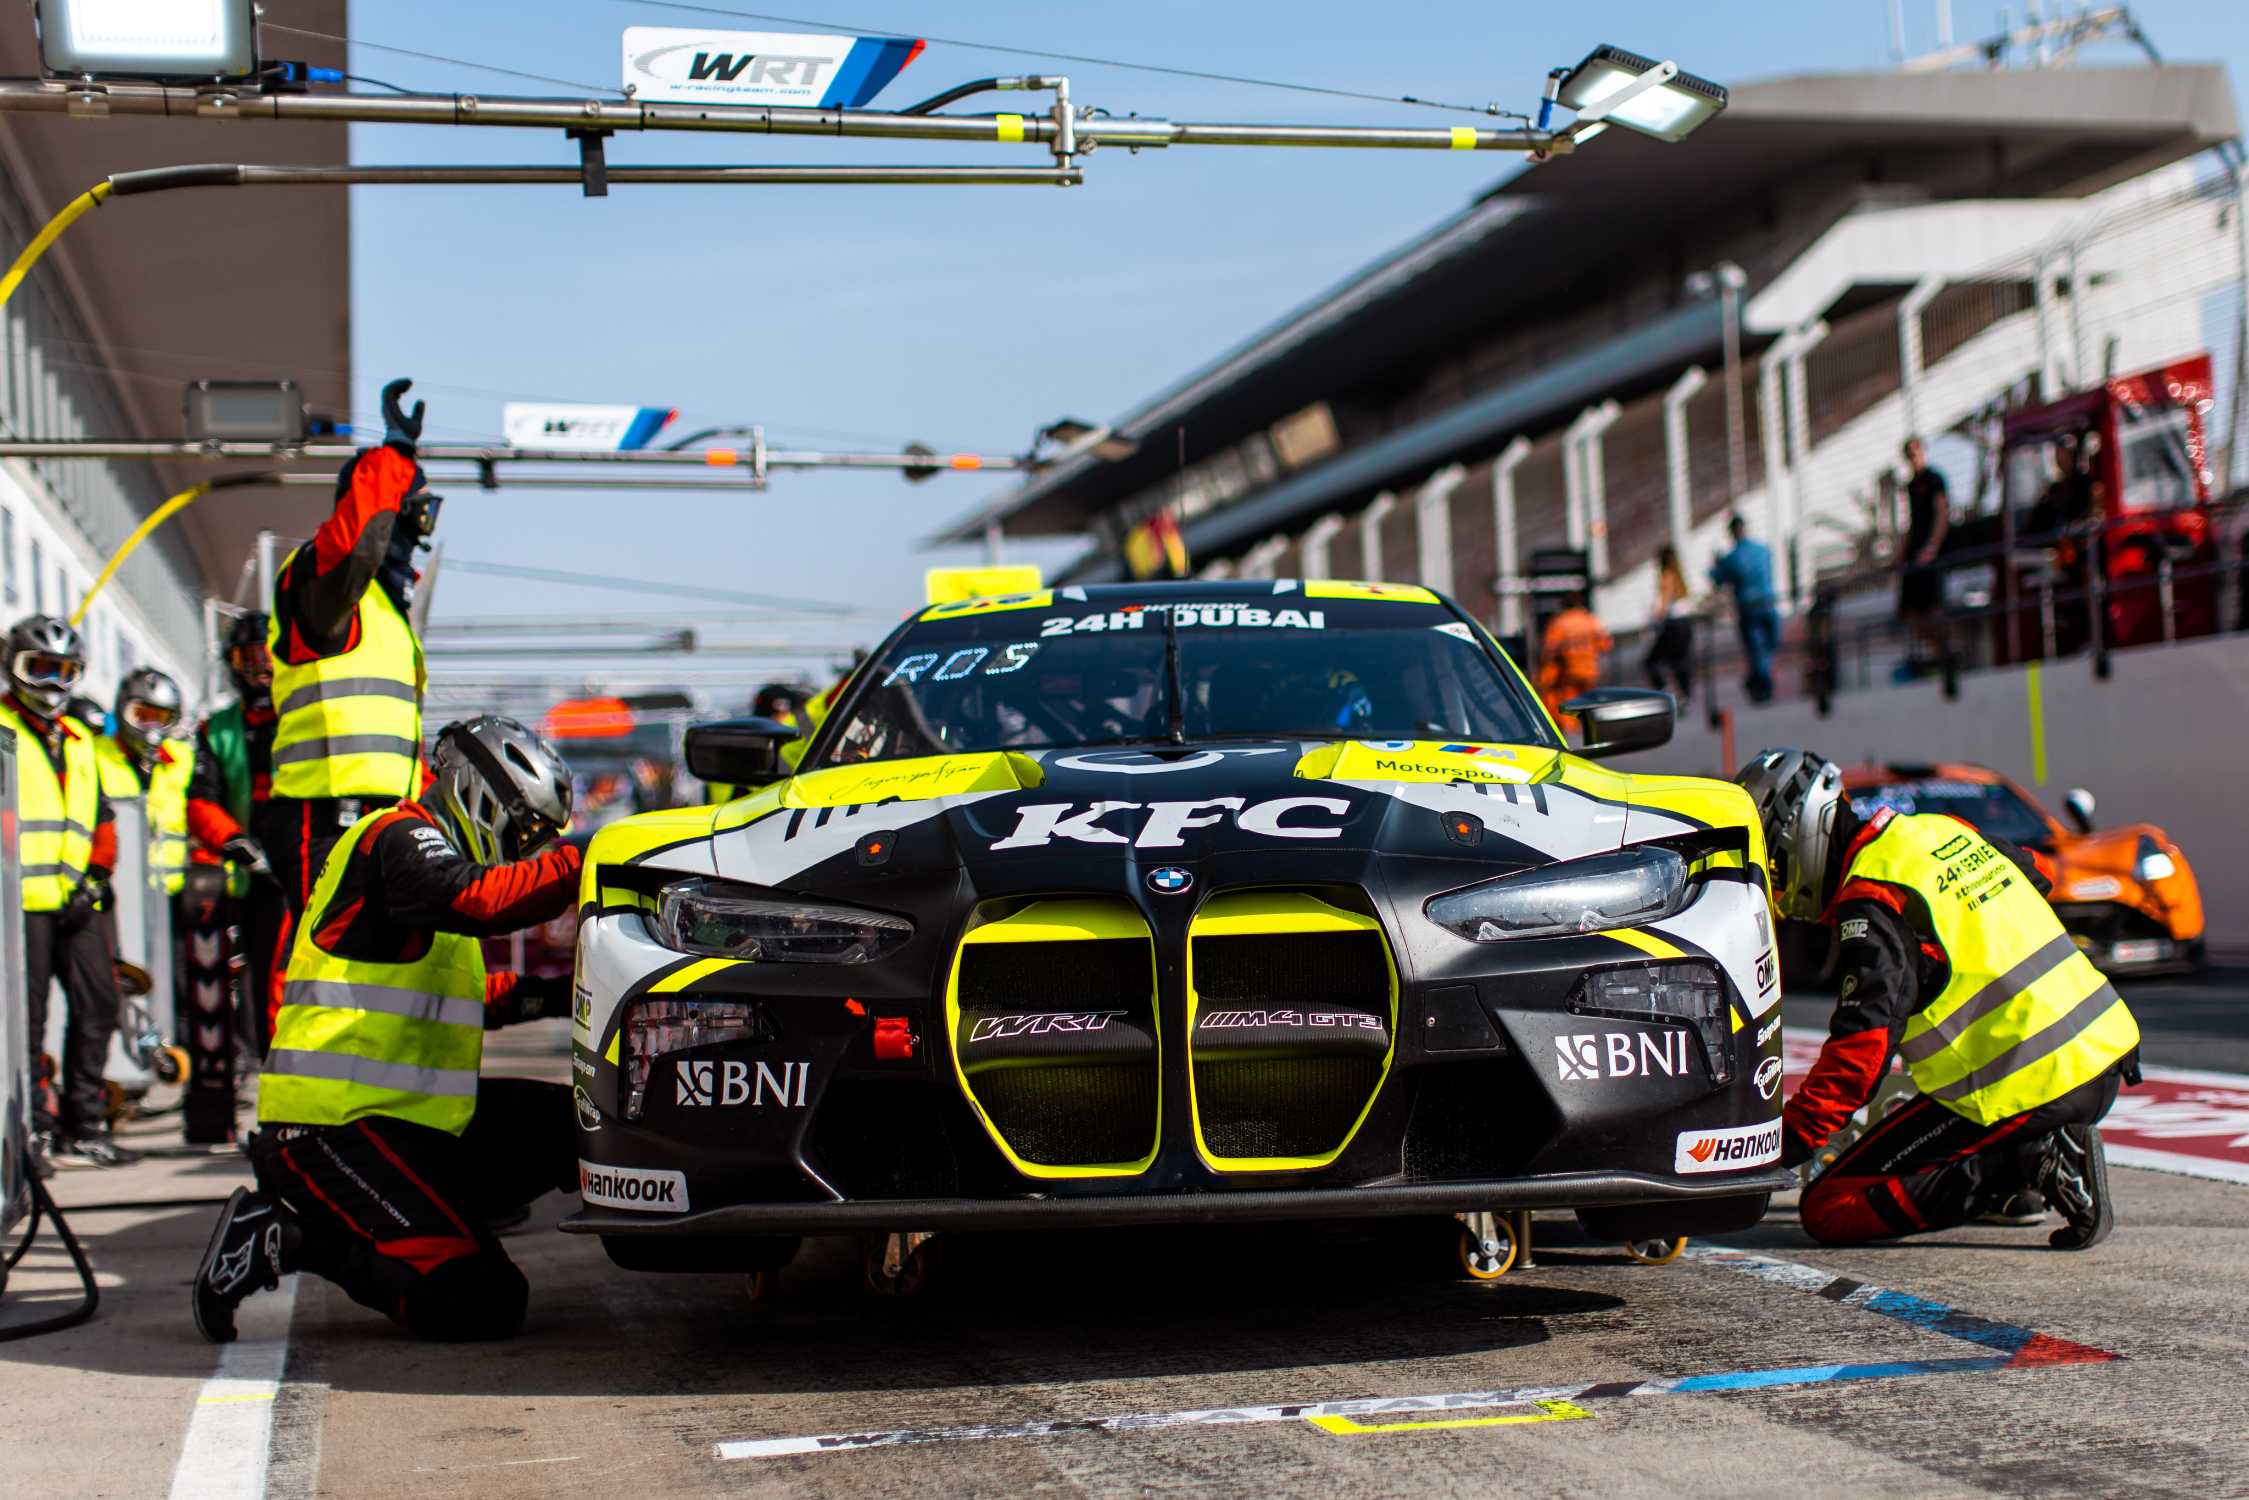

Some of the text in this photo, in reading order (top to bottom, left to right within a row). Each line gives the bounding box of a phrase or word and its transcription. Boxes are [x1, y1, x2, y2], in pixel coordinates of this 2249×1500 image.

[688, 52, 833, 85] WRT
[1041, 608, 1325, 637] 24H DUBAI
[990, 797, 1351, 850] KFC
[970, 1011, 1128, 1042] WRT
[1309, 1013, 1383, 1029] GT3
[1605, 1031, 1688, 1077] BNI
[720, 1060, 811, 1108] BNI
